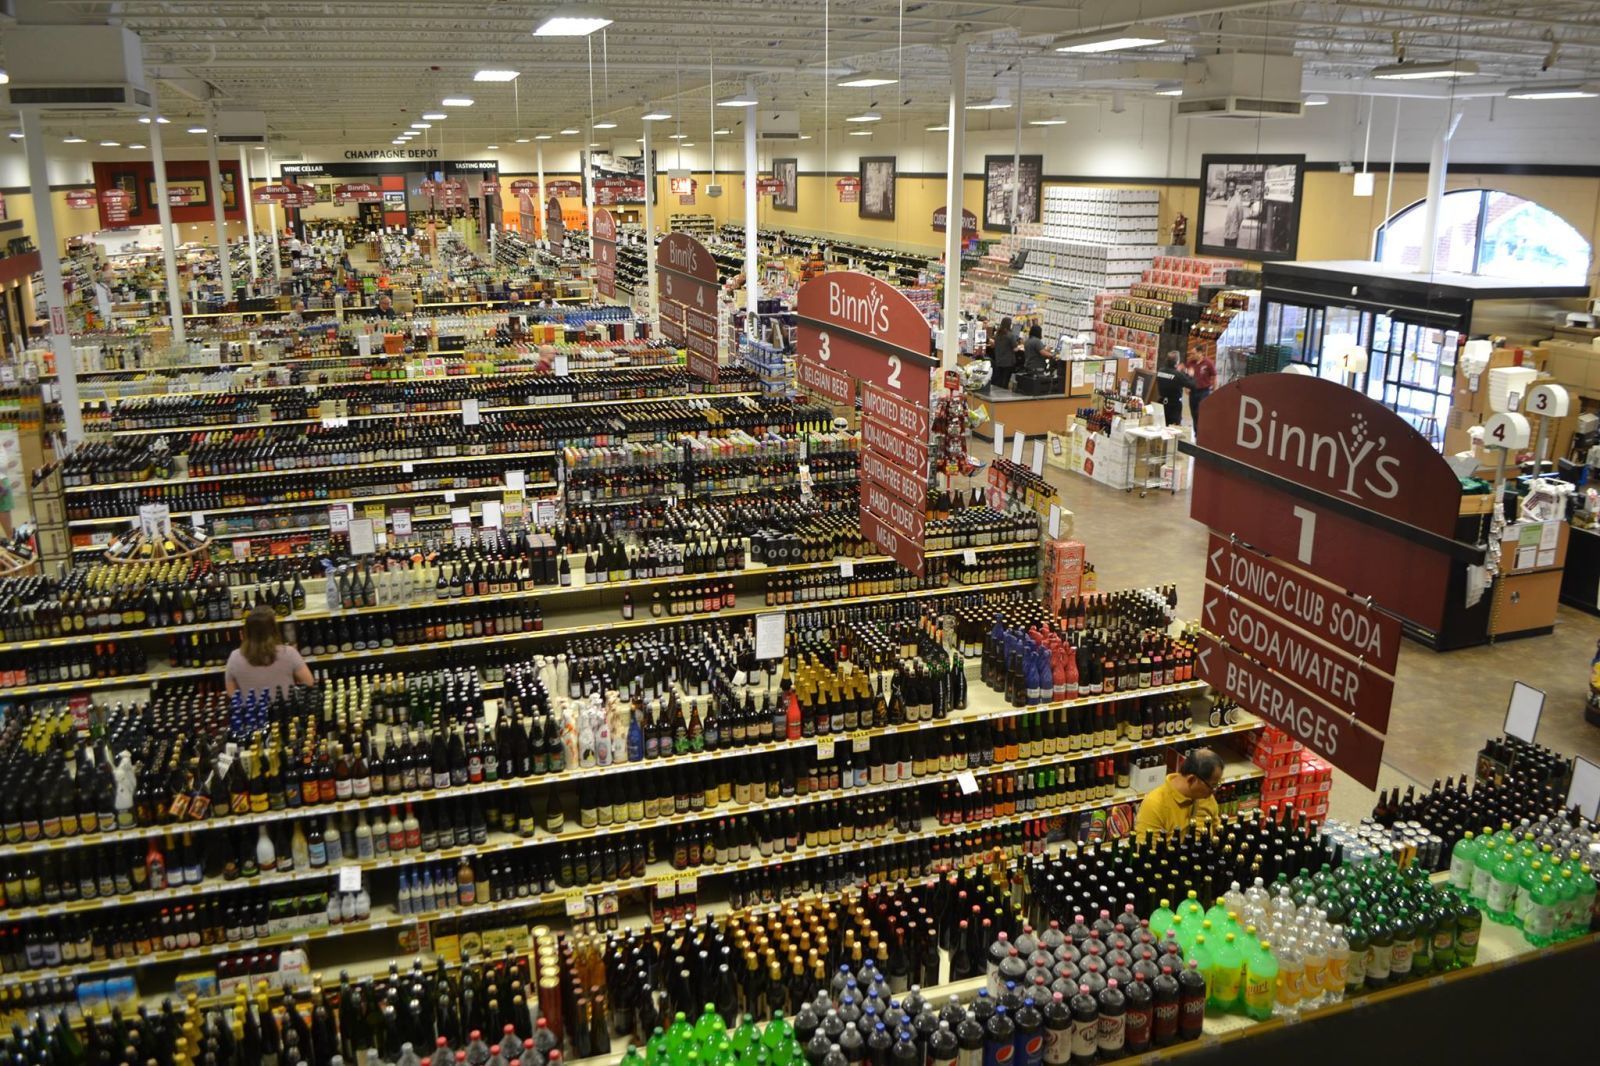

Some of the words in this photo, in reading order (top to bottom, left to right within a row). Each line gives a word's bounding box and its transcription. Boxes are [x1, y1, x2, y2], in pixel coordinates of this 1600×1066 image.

[344, 149, 406, 160] CHAMPAGNE
[408, 149, 438, 158] DEPOT
[602, 247, 607, 261] 6
[670, 240, 697, 273] Binny's
[666, 275, 672, 295] 5
[696, 286, 704, 308] 4
[829, 282, 889, 335] Binny's
[804, 364, 830, 392] BELGIAN
[831, 376, 849, 400] BEER
[818, 332, 830, 361] 3
[887, 355, 901, 388] 2
[1343, 354, 1349, 367] 1
[865, 388, 898, 422] IMPORTED
[899, 404, 917, 431] BEER
[1537, 394, 1547, 410] 3
[864, 420, 905, 460] NON-ALCOHOLIC
[906, 443, 918, 467] BEER
[1236, 395, 1400, 499] Binny's
[1493, 424, 1505, 441] 4
[863, 452, 900, 490] GLUTEN-FREE
[901, 476, 917, 501] BEER
[869, 487, 890, 515] HARD
[891, 503, 914, 533] CIDER
[876, 524, 897, 553] MEAD
[1293, 505, 1317, 566] 1
[1229, 552, 1323, 628] TONIC/CLUB
[1329, 601, 1381, 660] SODA
[1228, 609, 1359, 707] SODA/WATER
[1225, 661, 1338, 756] BEVERAGES
